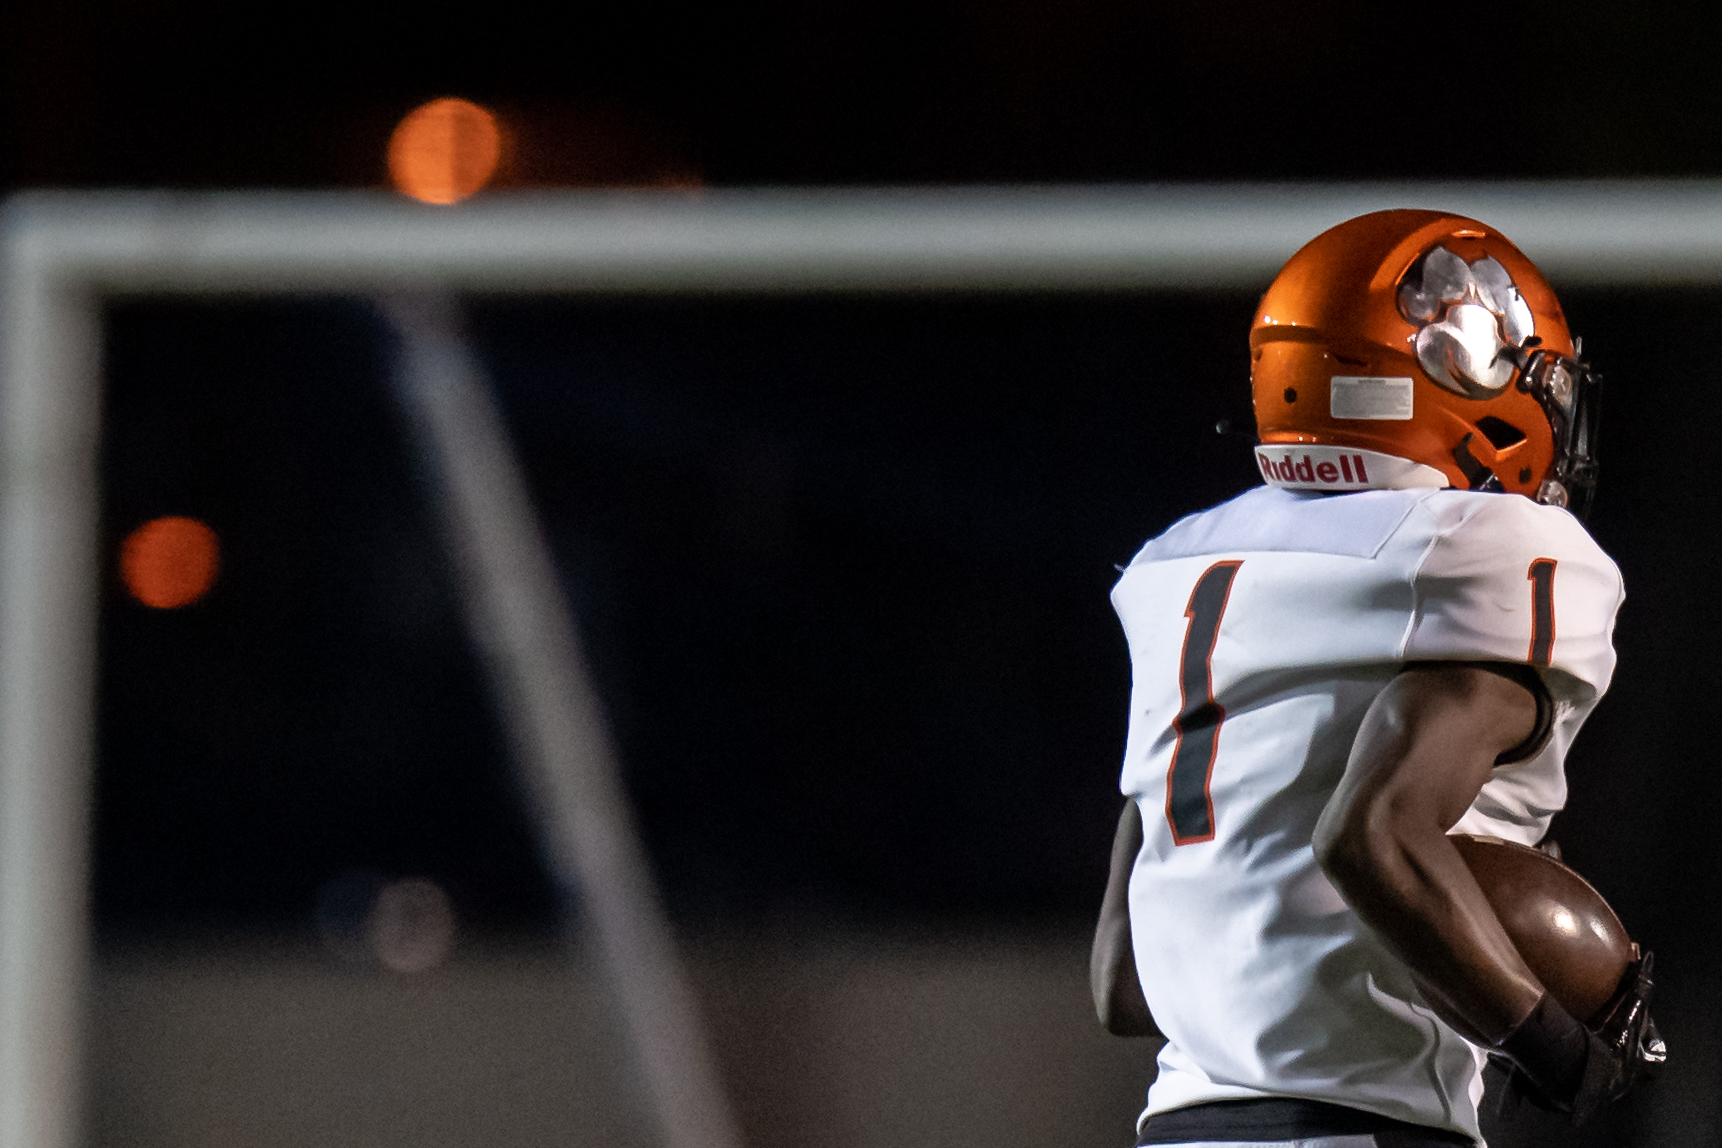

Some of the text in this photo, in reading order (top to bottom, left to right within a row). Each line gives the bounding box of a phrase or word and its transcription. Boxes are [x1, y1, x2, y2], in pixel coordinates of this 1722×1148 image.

[1258, 452, 1368, 483] Riddell
[1528, 558, 1557, 667] 1
[1165, 559, 1245, 846] 1
